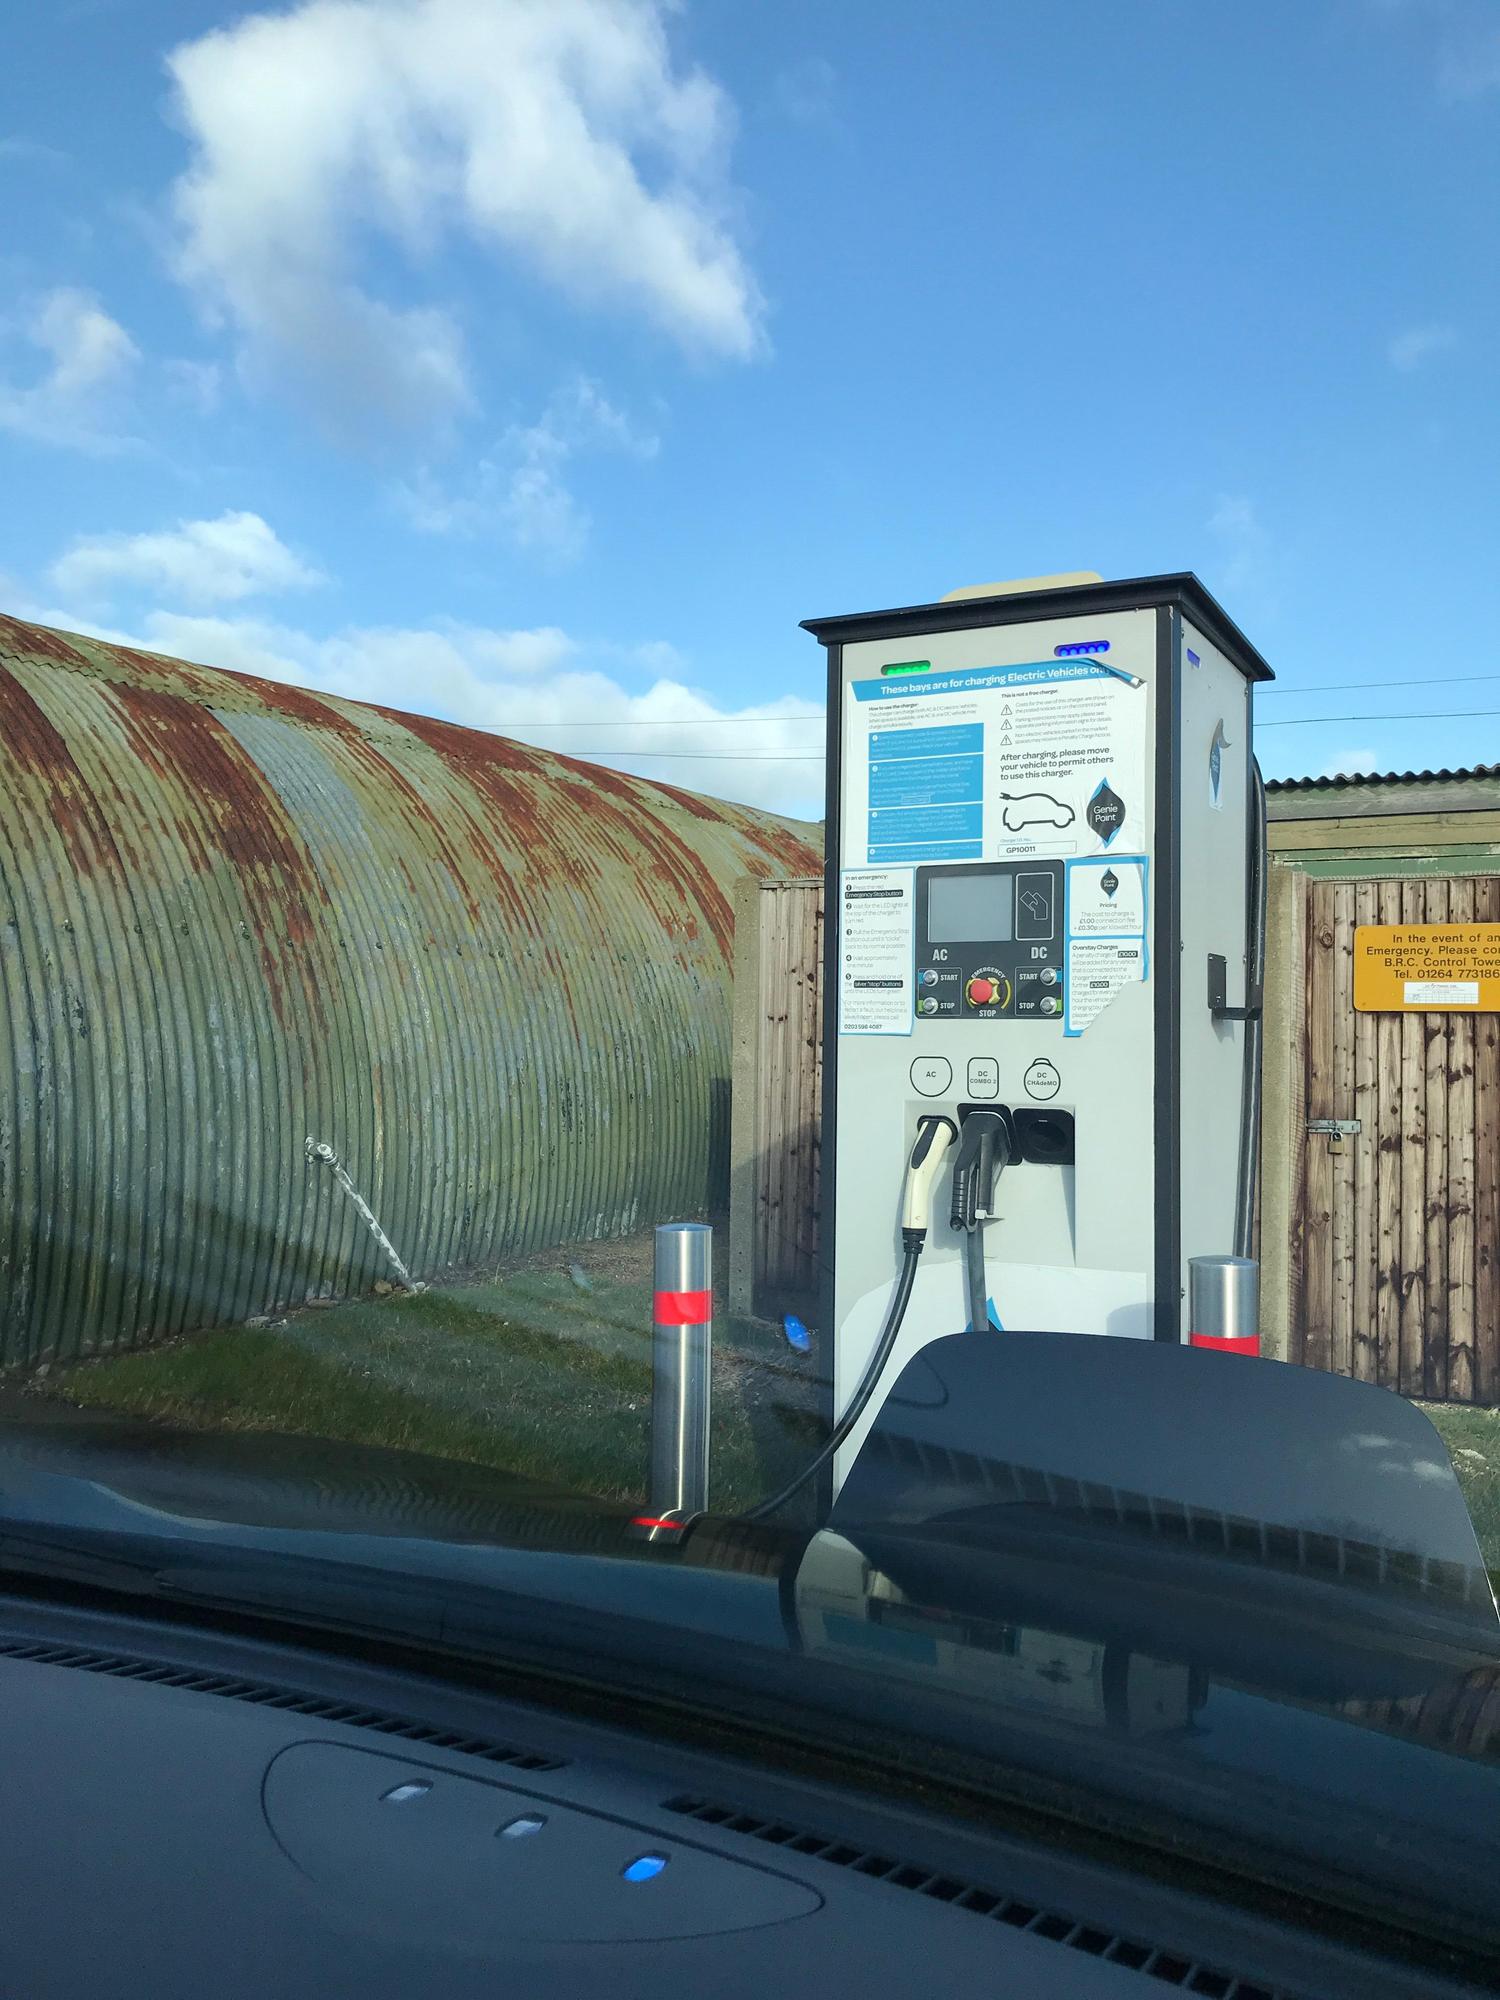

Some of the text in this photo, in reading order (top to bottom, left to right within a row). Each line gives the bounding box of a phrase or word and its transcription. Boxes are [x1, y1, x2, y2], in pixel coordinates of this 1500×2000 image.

[881, 686, 908, 695] These
[910, 684, 931, 693] bays
[933, 681, 948, 689] are
[950, 678, 964, 688] for
[965, 674, 1006, 686] charging
[1008, 670, 1046, 680] Electric
[1047, 667, 1088, 678] Vehicles
[1022, 751, 1058, 760] charging,
[1060, 749, 1085, 758] please
[1000, 764, 1018, 772] your
[1020, 760, 1047, 769] vehicle
[1059, 757, 1086, 768] permit
[1087, 756, 1113, 764] others
[1026, 770, 1039, 778] this
[1042, 769, 1073, 778] charger.
[1094, 803, 1118, 813] Genie
[1095, 814, 1116, 822] Point
[1393, 934, 1402, 943] In
[1408, 934, 1426, 943] the
[1432, 934, 1463, 943] event
[1469, 933, 1481, 943] of
[933, 948, 948, 961] AC
[1031, 946, 1047, 959] DC
[1366, 946, 1433, 956] Emergency.
[1439, 945, 1477, 955] Please
[1385, 958, 1418, 967] B.R.C.
[1424, 957, 1466, 967] Control
[971, 967, 1006, 979] EMERGENCY
[1394, 969, 1499, 979] Tel. 01264 773186
[979, 1009, 997, 1018] STOP
